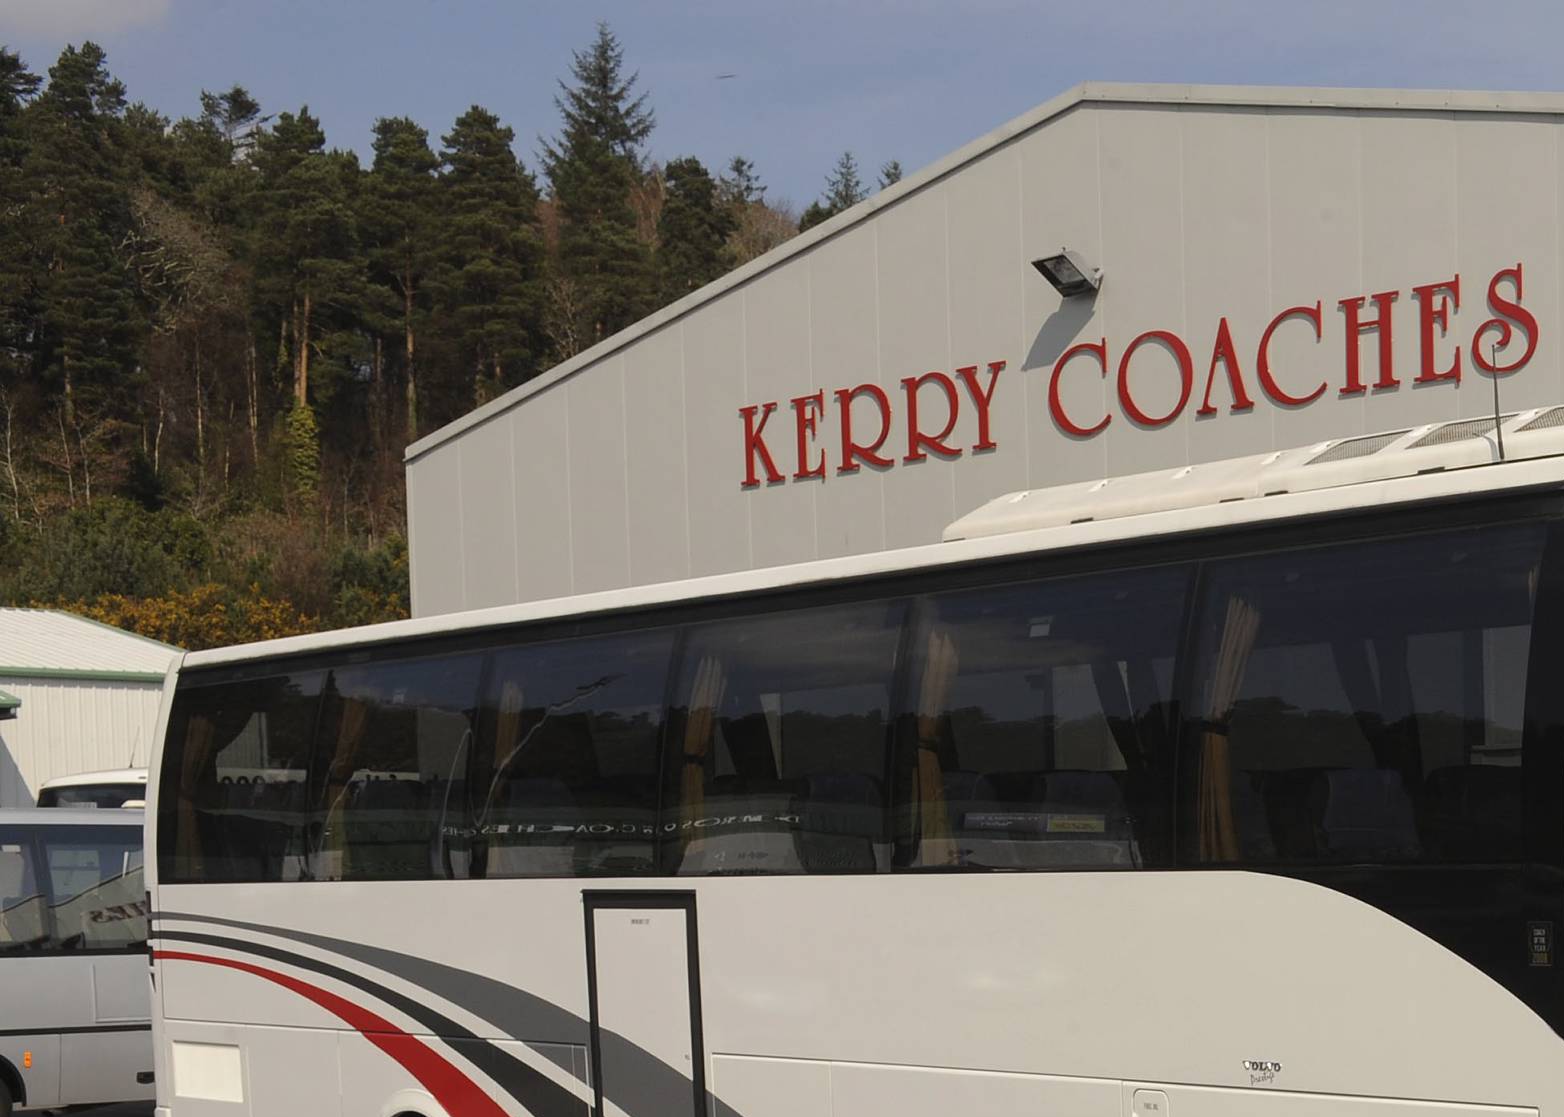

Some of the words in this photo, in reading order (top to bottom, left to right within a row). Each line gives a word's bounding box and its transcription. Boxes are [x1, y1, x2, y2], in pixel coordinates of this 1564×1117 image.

[738, 361, 1006, 488] KERRY
[1048, 263, 1539, 438] COACHES
[1242, 1060, 1281, 1072] VOLVO
